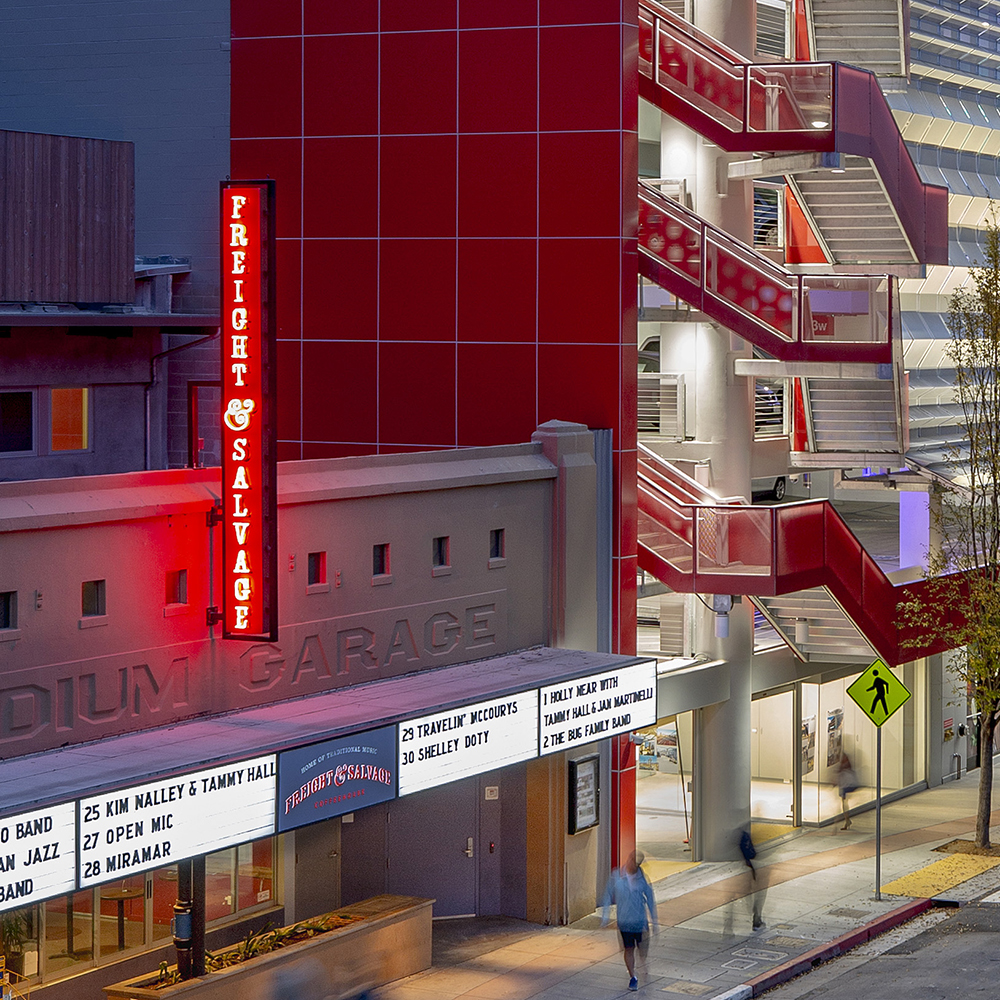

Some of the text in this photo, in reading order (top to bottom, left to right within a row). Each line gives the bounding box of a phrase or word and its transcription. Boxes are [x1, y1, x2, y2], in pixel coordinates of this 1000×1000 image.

[223, 195, 256, 630] FREIGHT & SALVAGE
[239, 602, 497, 694] GARAGE
[544, 687, 654, 727] TAMMY HALL & JAN MARTINELLI
[550, 686, 574, 705] HOLLY
[576, 681, 598, 698] NEAR
[600, 675, 619, 691] WITH
[401, 701, 519, 743] 29 TRAVELIN' MCCOURYS
[543, 713, 632, 749] 2 THE BUG FAMILY BAND
[301, 746, 378, 775] HOME OF TRADITIONAL MUSIC
[401, 730, 490, 766] 30 SHELLEY DOTY
[83, 762, 277, 823] 25 KIM NALLEY & TAMMY HALL
[284, 763, 391, 815] FREIGHT & SALVAGE
[314, 788, 366, 809] COFFEEHOUSE
[16, 815, 53, 840] BAND
[82, 813, 174, 851] 27 OPEN MIC
[23, 841, 60, 867] JAZZ
[84, 841, 172, 879] 28 MIRAMAR
